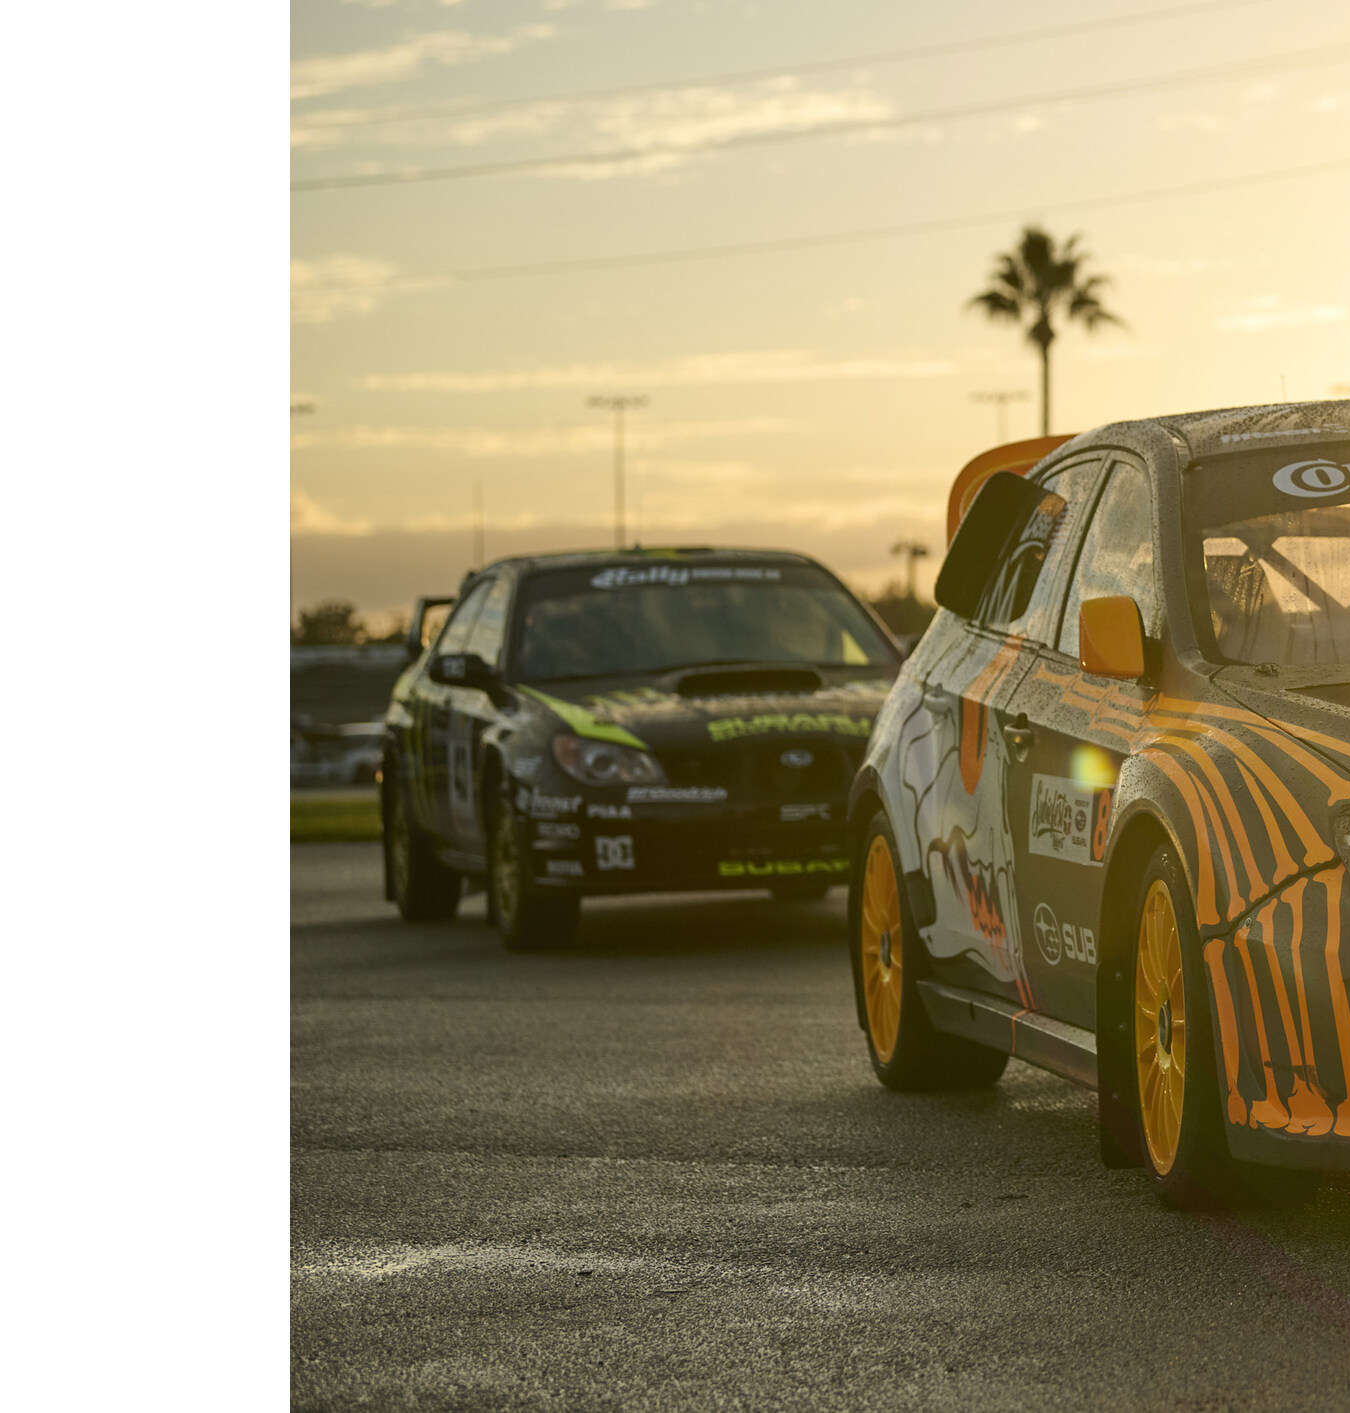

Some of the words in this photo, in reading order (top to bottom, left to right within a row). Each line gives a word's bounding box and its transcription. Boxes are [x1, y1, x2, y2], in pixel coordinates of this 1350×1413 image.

[587, 804, 632, 819] PIAA
[595, 835, 635, 870] DC
[1062, 923, 1096, 965] SUB
